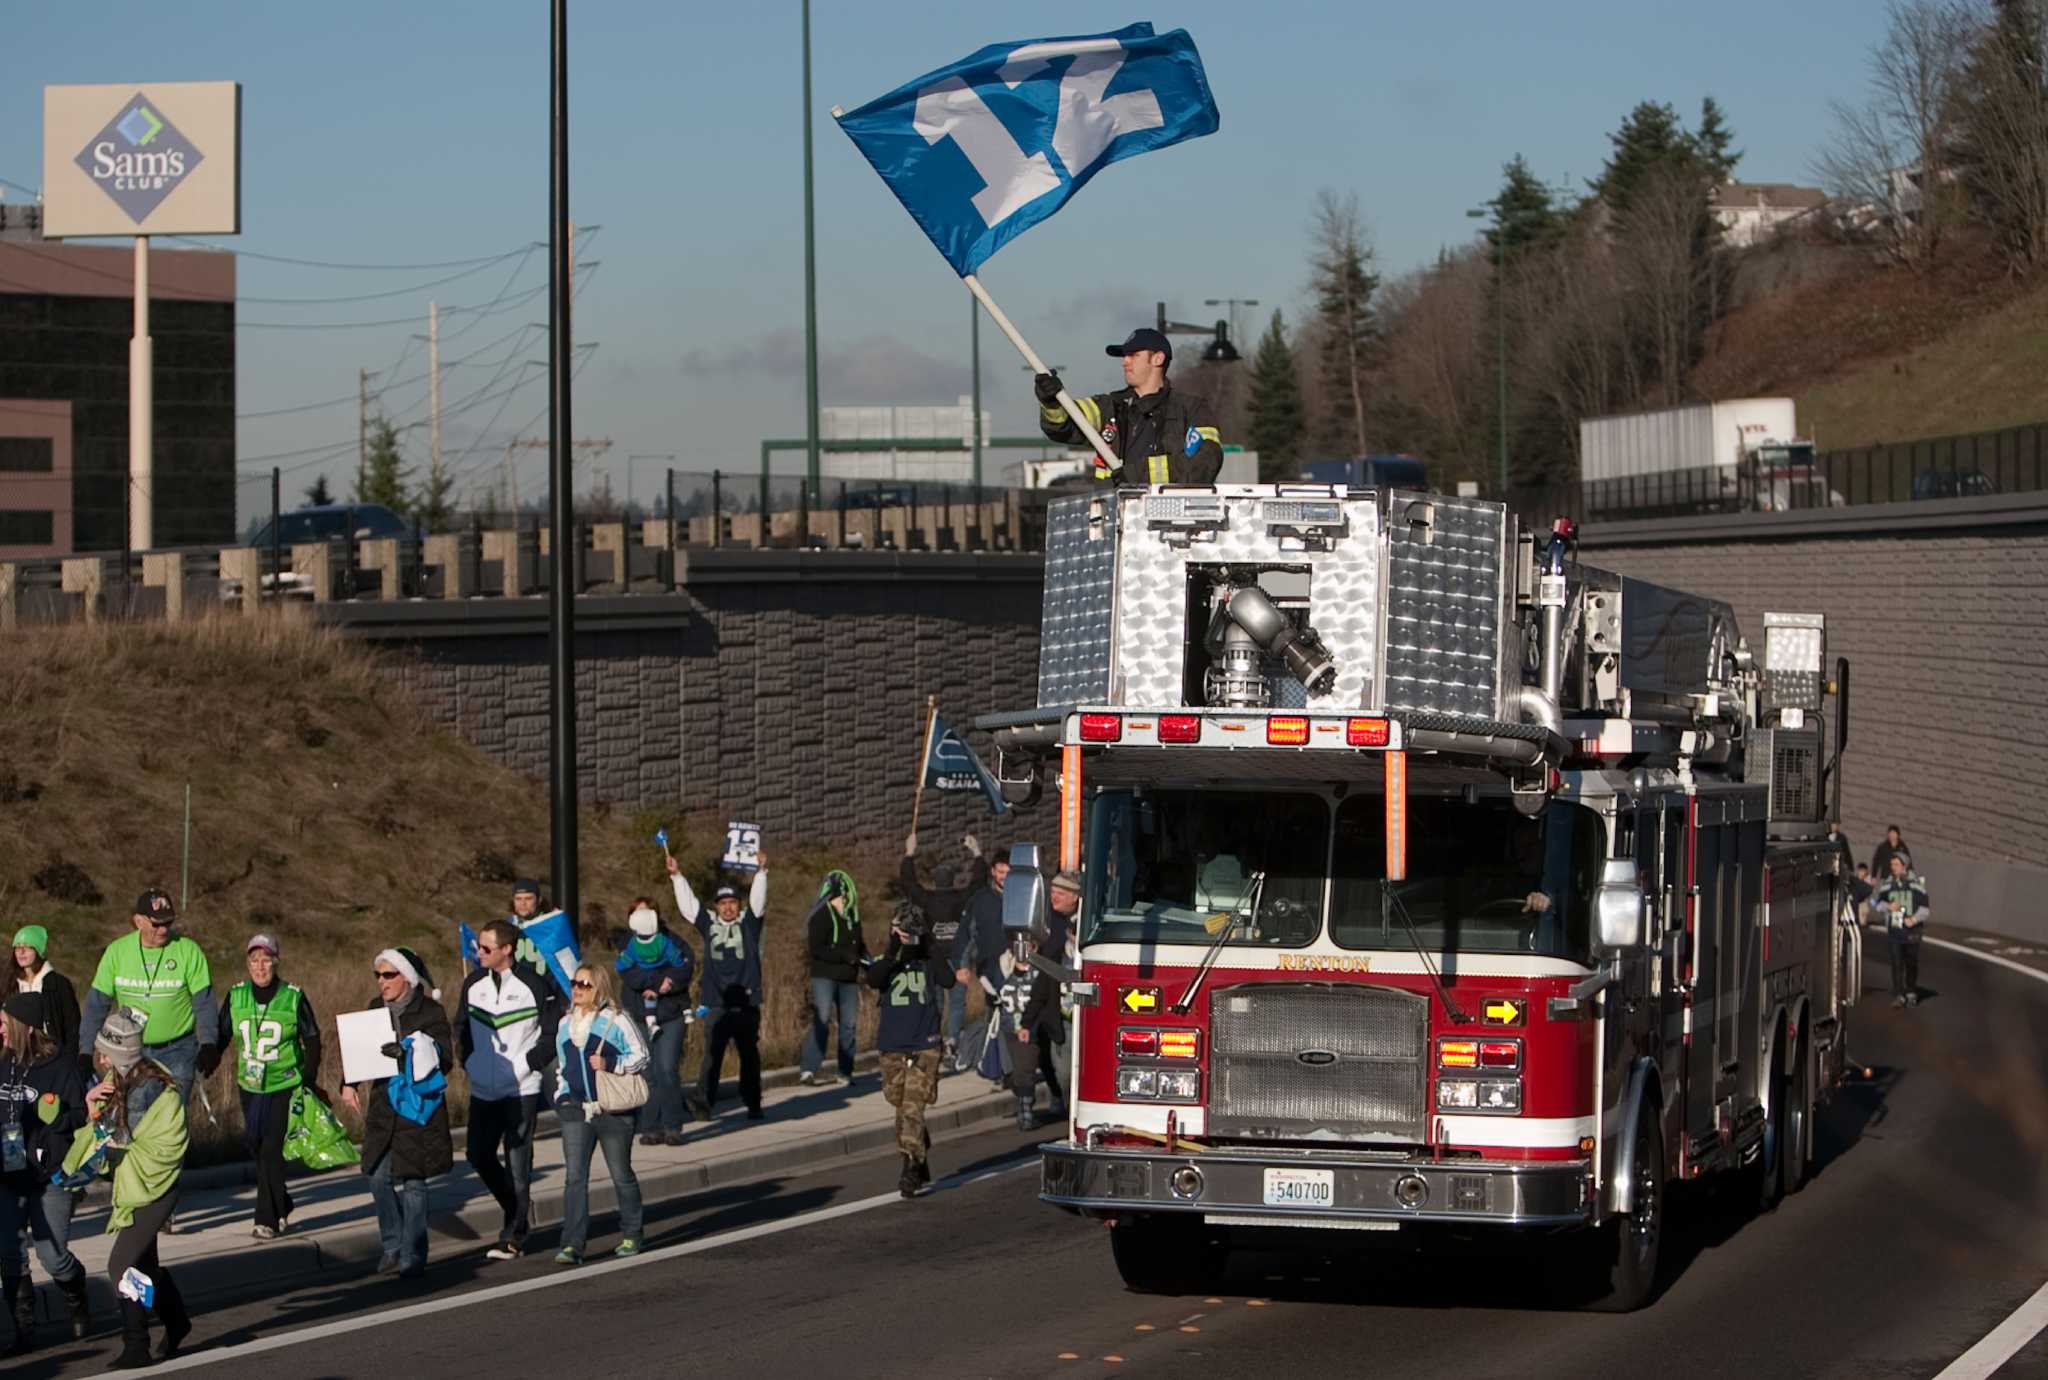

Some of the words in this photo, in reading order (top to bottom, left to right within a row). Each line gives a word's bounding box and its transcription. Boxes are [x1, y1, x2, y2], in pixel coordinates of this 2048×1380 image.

[913, 38, 1164, 229] 12
[93, 141, 185, 178] Sam's
[115, 177, 163, 190] CLUB
[709, 923, 744, 960] 24
[1279, 953, 1371, 973] RENTON
[891, 971, 926, 1006] 24
[239, 1020, 282, 1061] 12
[1277, 1181, 1329, 1200] 54070D
